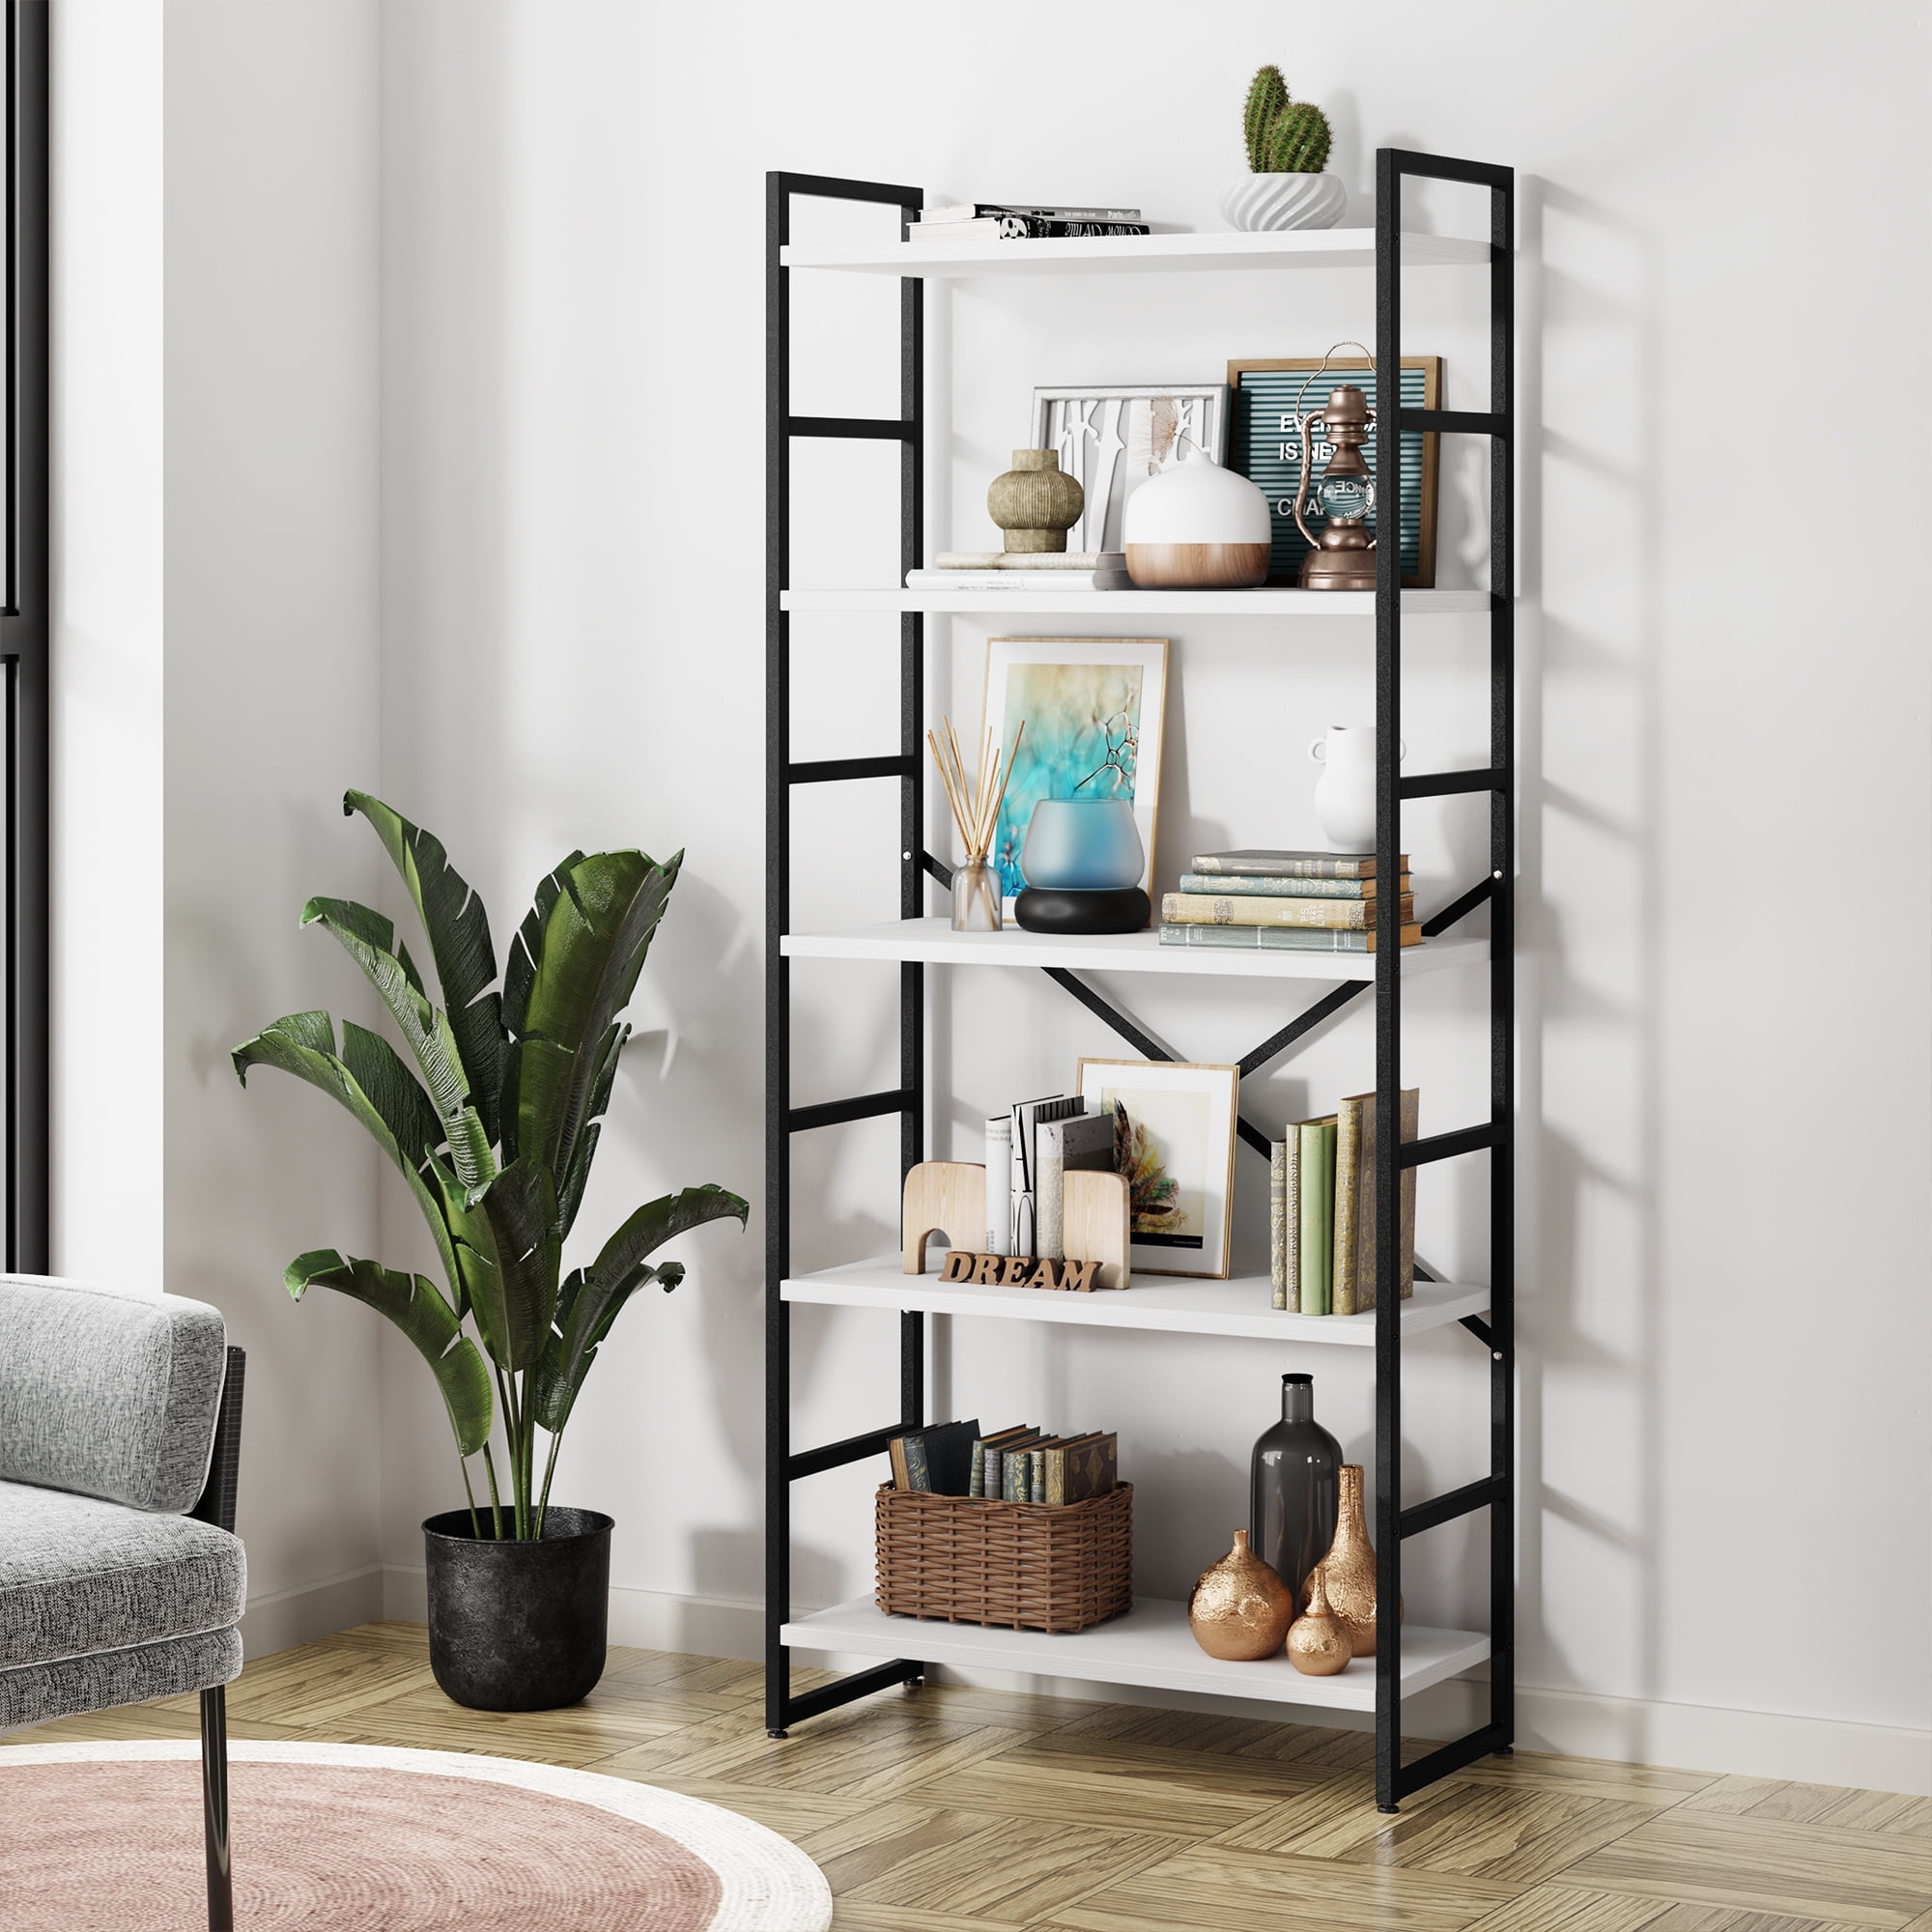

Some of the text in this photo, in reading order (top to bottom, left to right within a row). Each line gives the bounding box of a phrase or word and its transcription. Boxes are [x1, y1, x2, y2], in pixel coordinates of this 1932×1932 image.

[1279, 441, 1337, 461] IS NE
[938, 1252, 1102, 1293] DREAM
